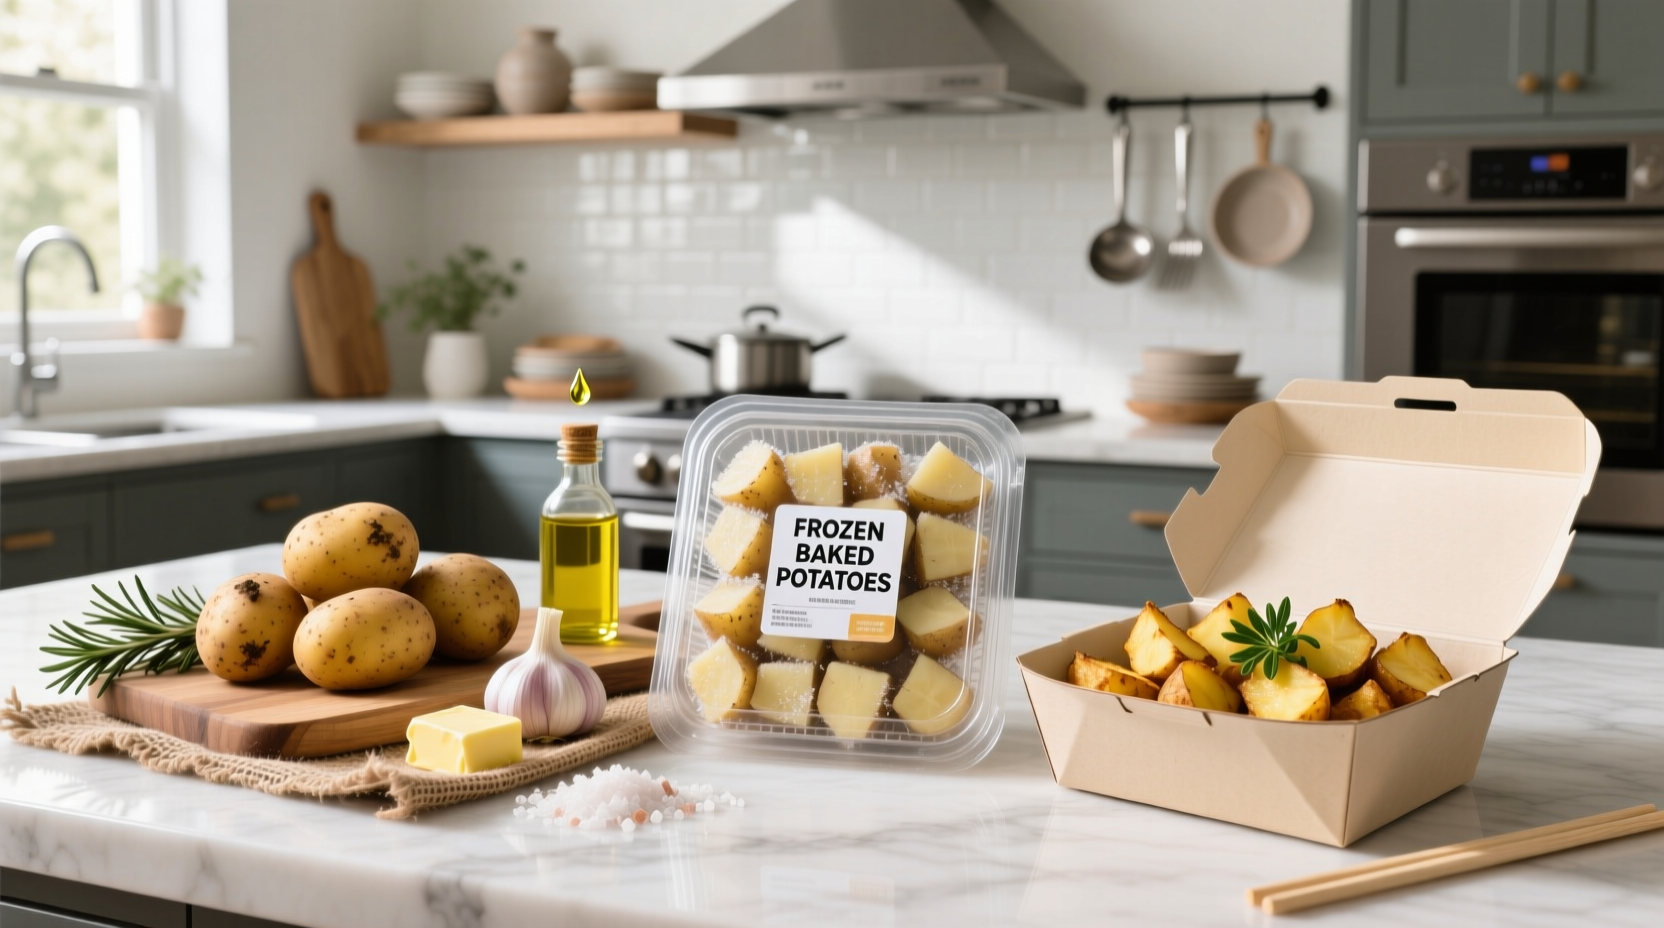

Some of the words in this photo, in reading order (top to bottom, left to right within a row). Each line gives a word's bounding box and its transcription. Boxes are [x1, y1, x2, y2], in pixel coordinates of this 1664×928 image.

[793, 517, 885, 541] FROZEN
[795, 543, 875, 566] BAKED
[775, 567, 892, 592] POTATOES
